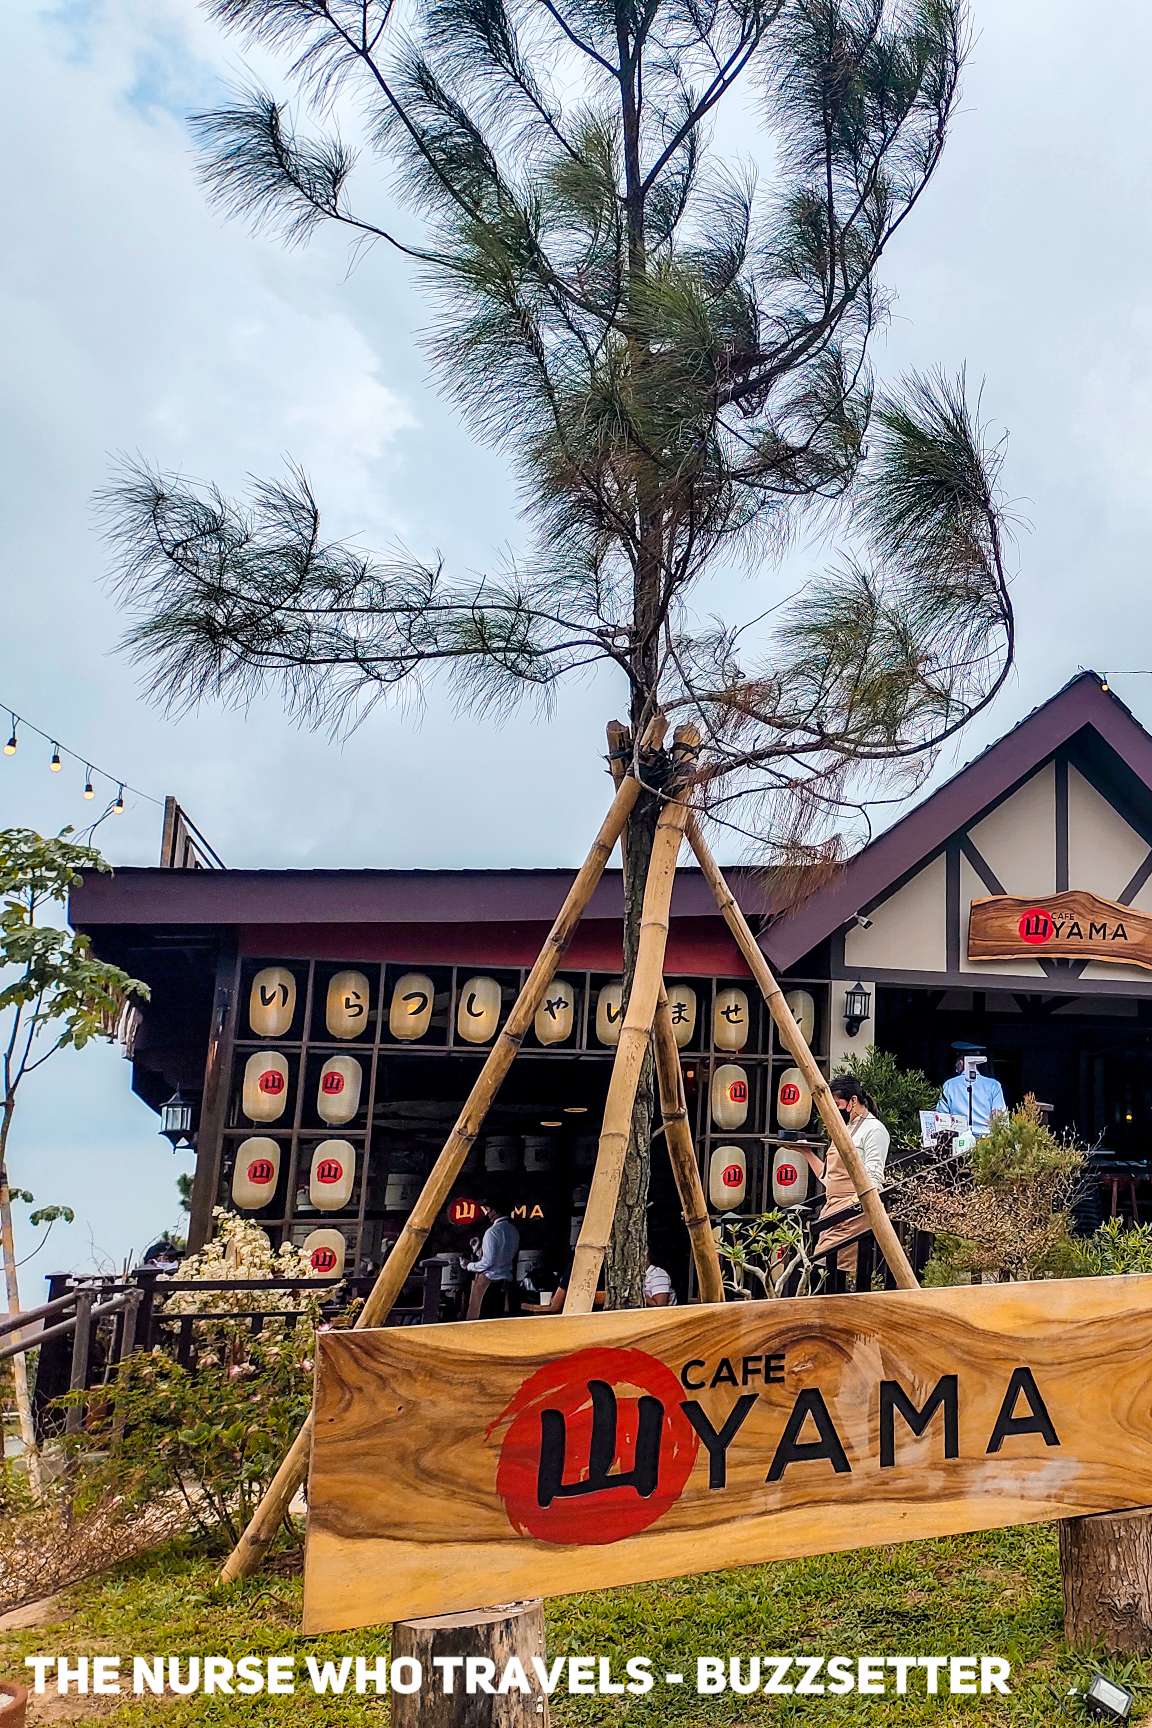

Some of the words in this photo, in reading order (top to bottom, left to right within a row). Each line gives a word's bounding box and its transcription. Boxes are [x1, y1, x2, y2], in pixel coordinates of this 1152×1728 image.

[1051, 911, 1075, 921] CAFE
[1052, 921, 1128, 941] YAMA
[680, 1353, 787, 1391] CAFE
[679, 1365, 1062, 1491] YAMA
